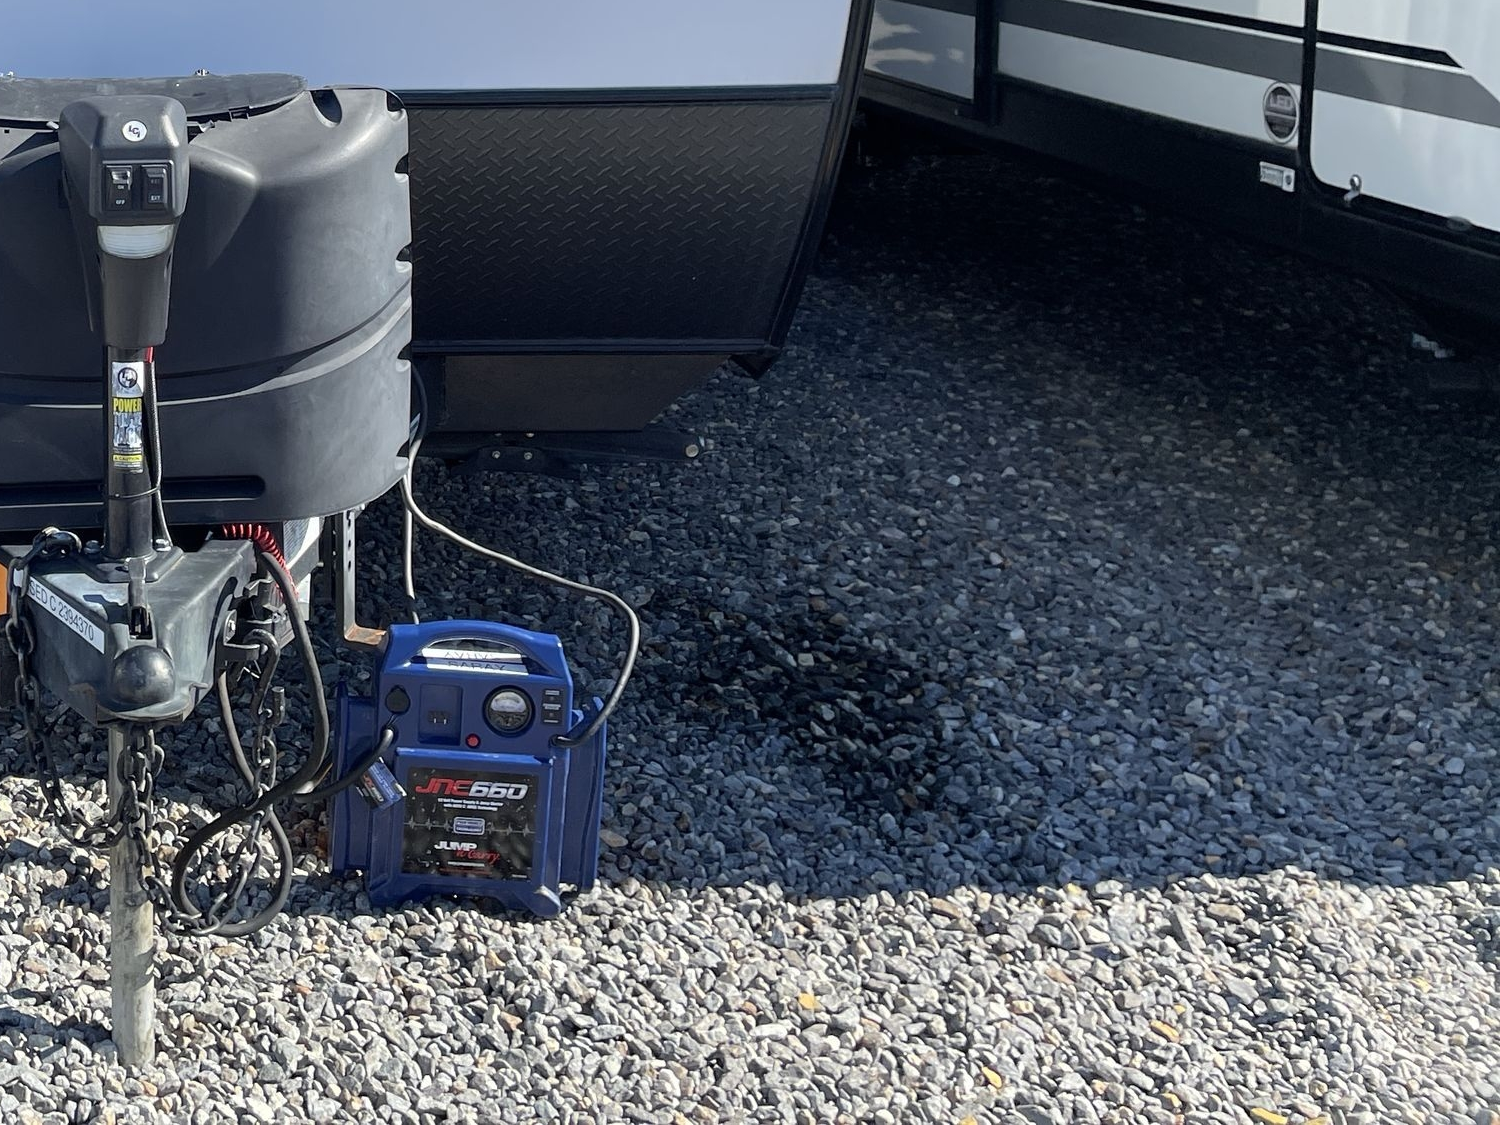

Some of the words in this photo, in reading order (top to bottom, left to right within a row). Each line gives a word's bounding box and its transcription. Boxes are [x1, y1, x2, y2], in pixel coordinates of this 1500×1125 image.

[113, 398, 142, 413] POWER
[49, 597, 57, 612] C
[434, 840, 478, 851] JUMP
